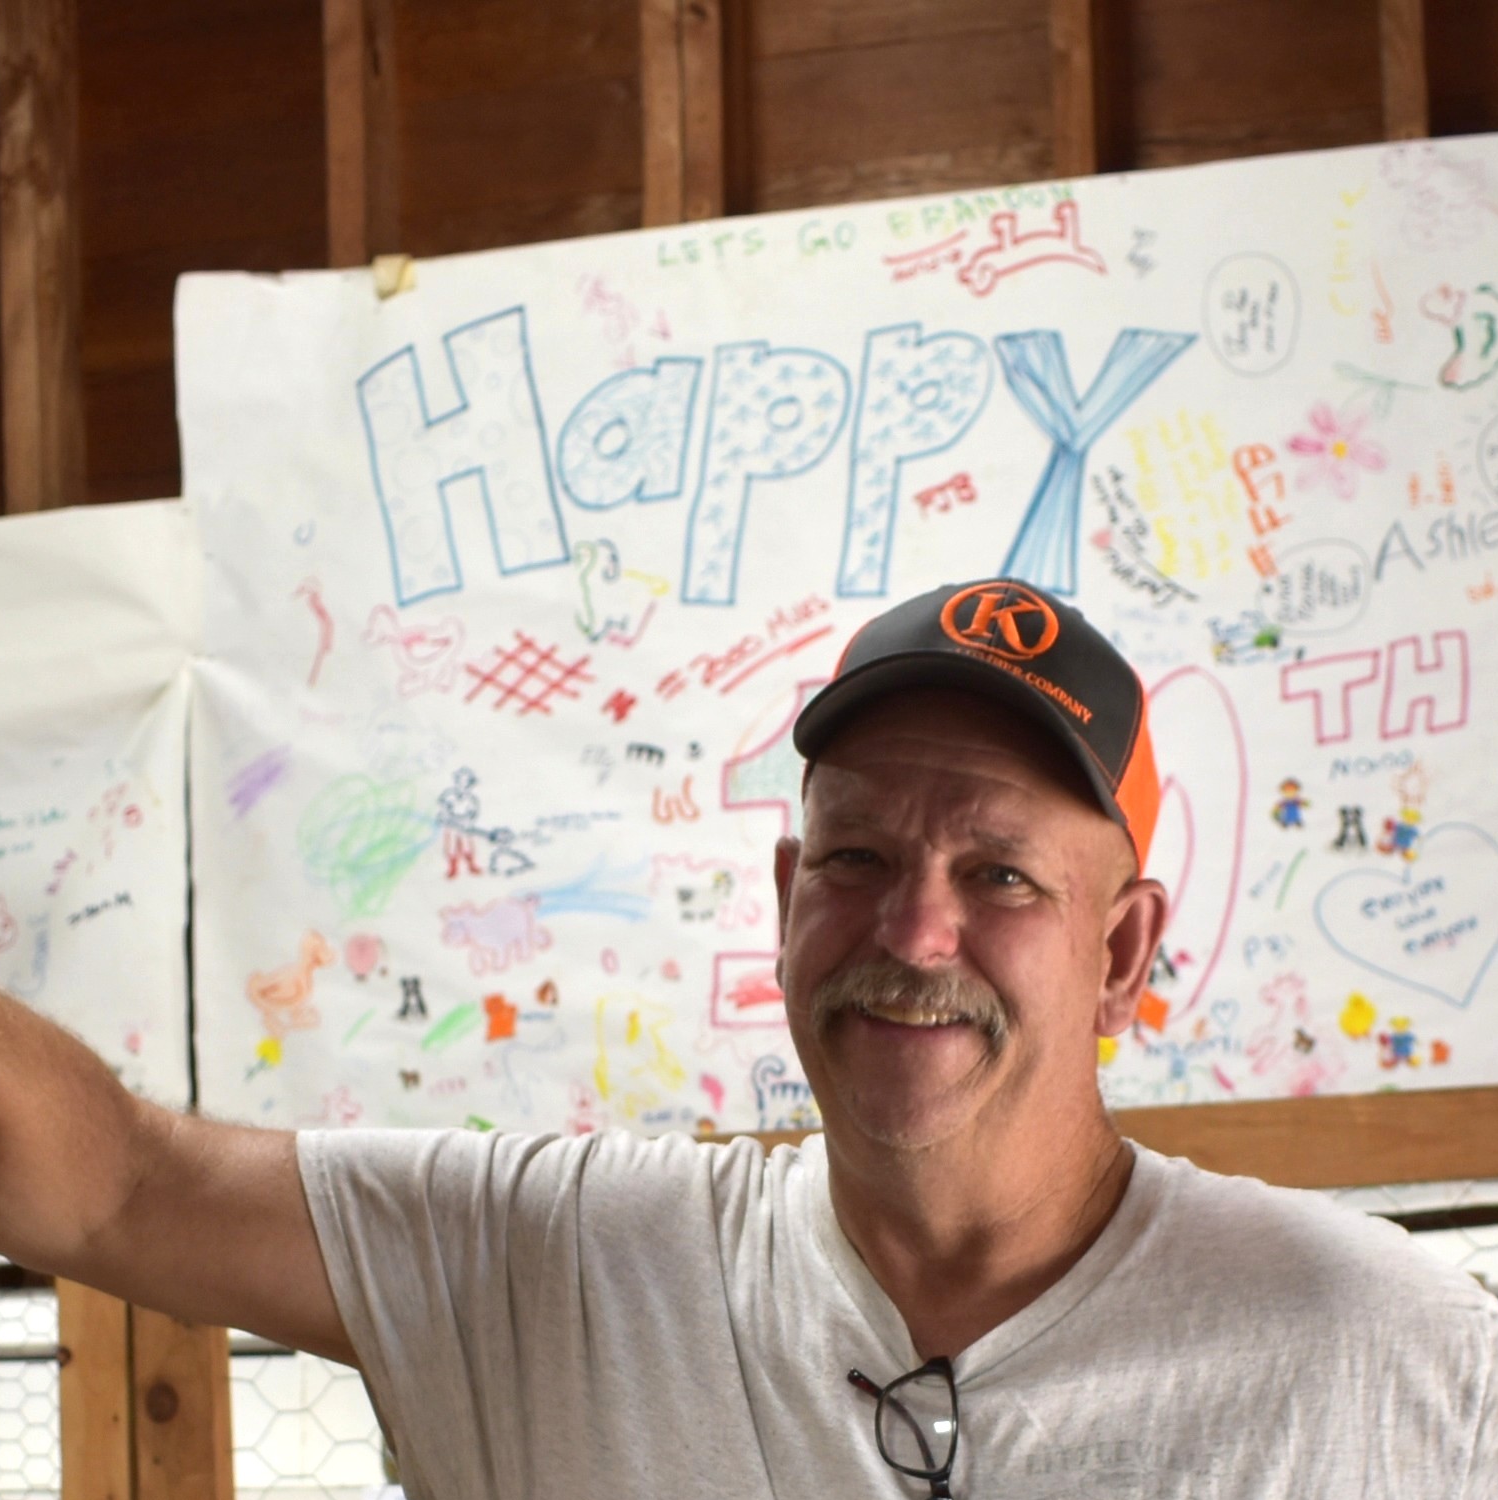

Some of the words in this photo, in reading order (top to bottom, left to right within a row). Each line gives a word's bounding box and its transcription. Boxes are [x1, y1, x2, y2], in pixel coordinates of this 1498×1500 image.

[797, 219, 857, 255] GO
[1024, 671, 1094, 725] COMPANY
[1281, 629, 1468, 747] TH
